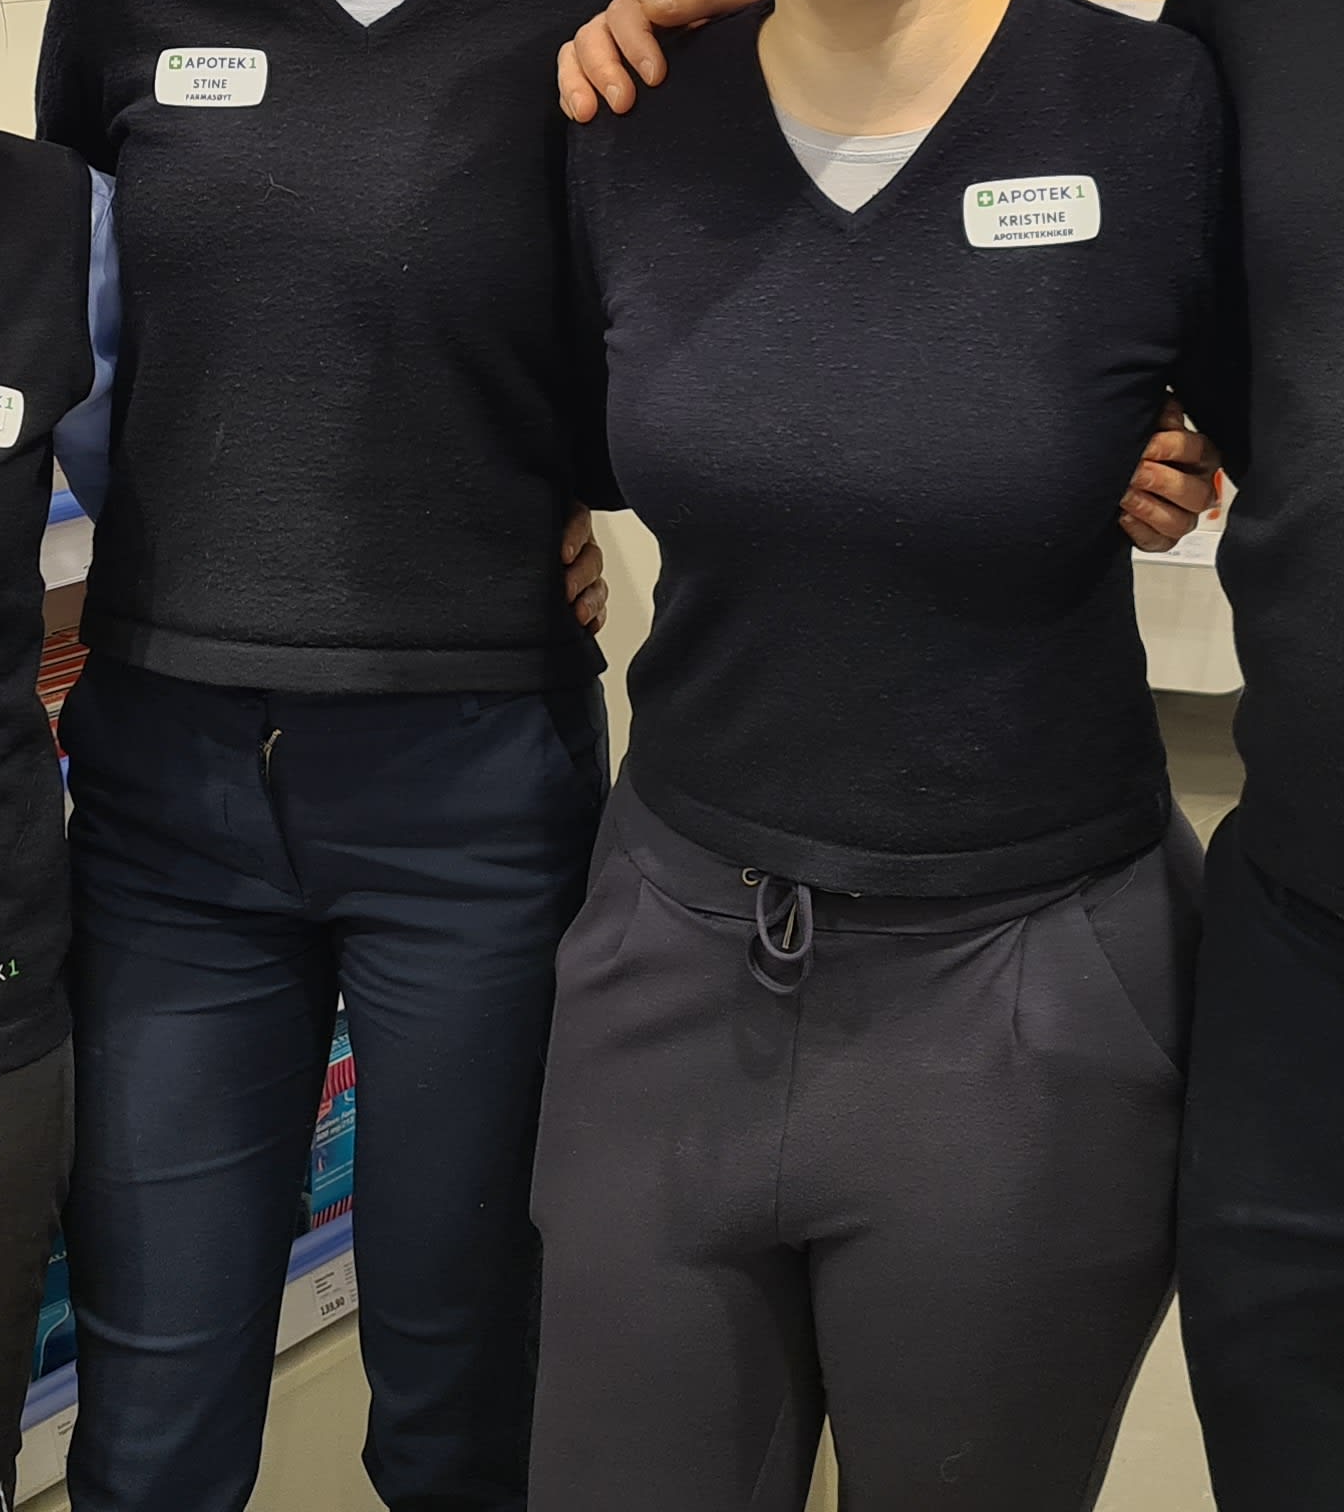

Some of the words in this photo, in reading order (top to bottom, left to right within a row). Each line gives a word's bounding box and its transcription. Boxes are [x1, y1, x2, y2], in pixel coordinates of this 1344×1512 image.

[185, 57, 247, 69] APOTEK
[249, 57, 257, 69] 1
[193, 79, 227, 89] STINE
[997, 186, 1072, 204] APOTEK
[1075, 184, 1086, 198] 1
[999, 212, 1067, 227] KRISTINE
[993, 228, 1074, 241] APOTEKTEKNIKER
[4, 396, 14, 410] 1
[8, 959, 19, 976] 1
